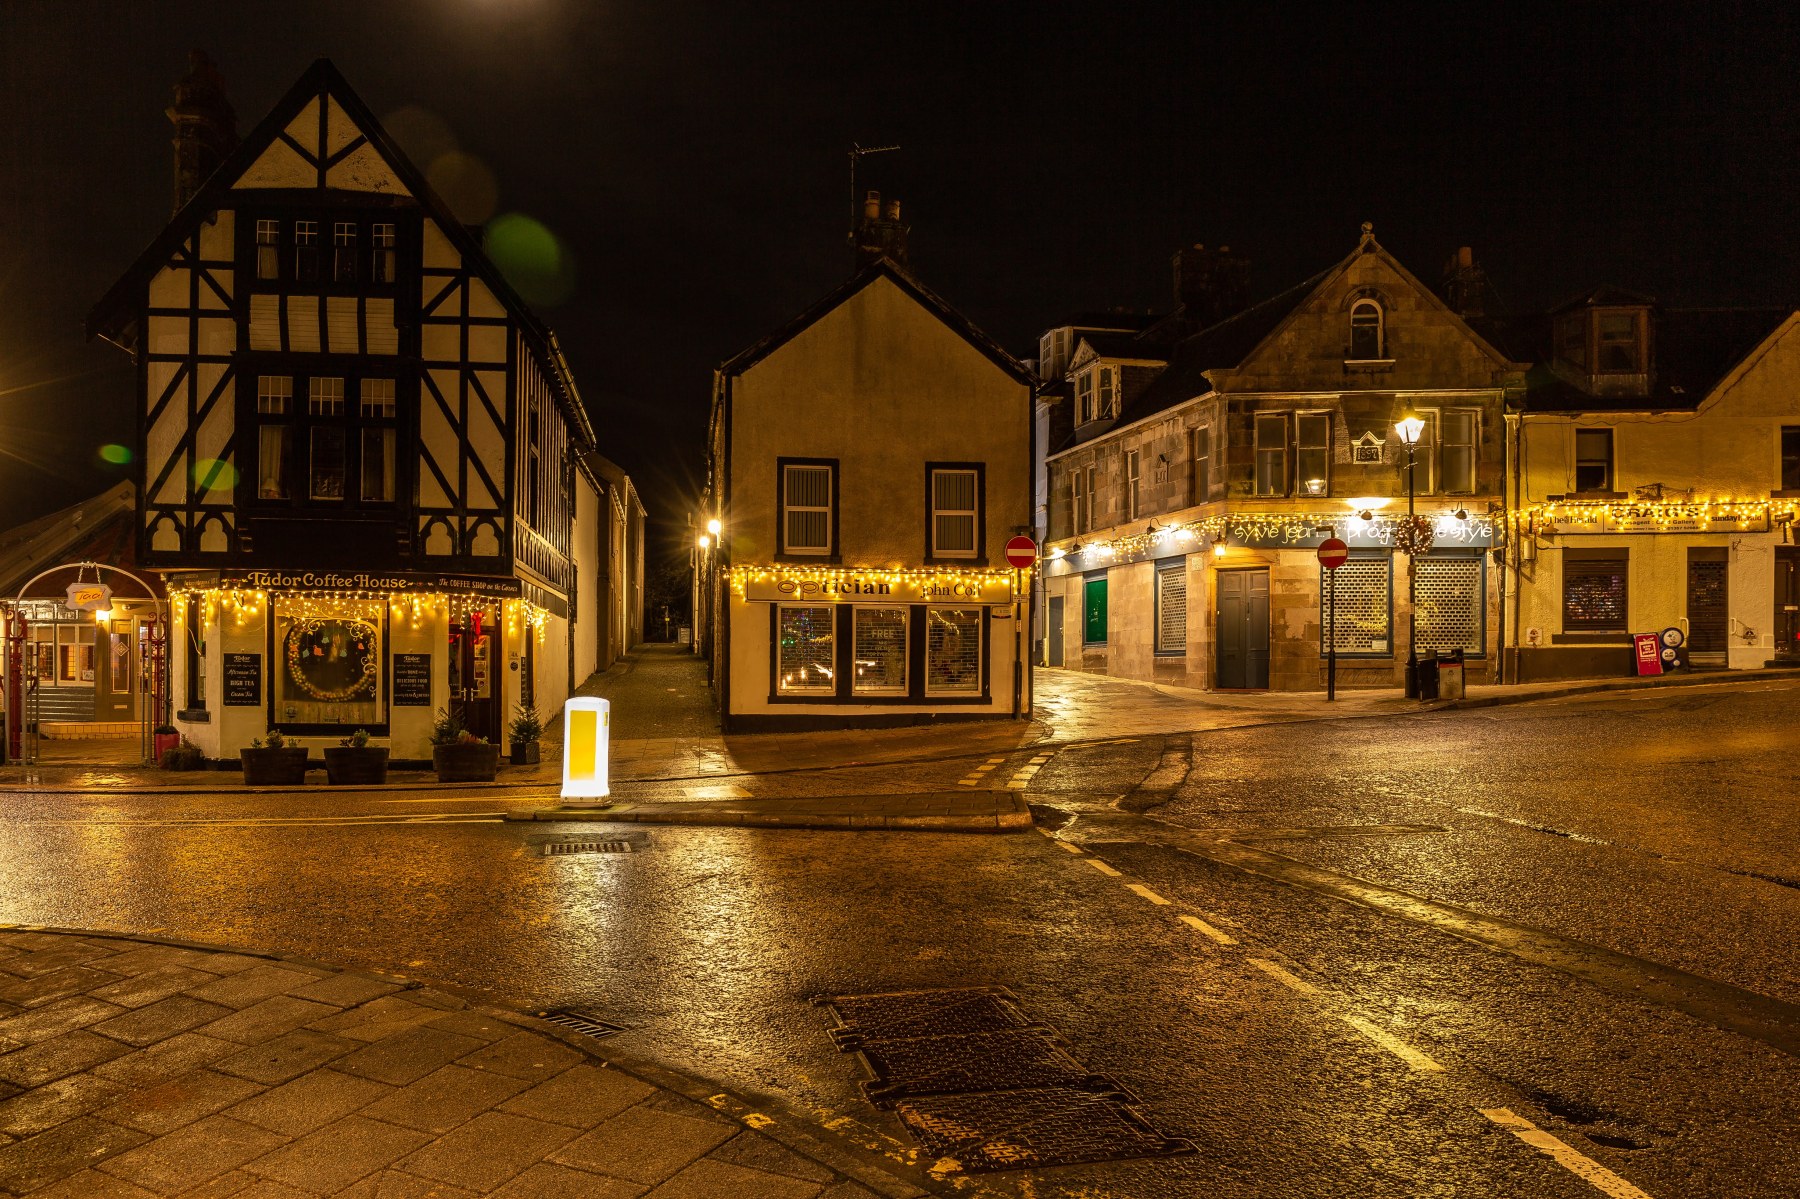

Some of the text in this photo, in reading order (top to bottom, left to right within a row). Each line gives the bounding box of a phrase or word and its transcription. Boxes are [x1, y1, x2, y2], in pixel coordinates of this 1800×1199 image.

[1611, 507, 1699, 518] CRAIG'S
[1548, 516, 1564, 524] The
[1234, 525, 1279, 544] syvie
[1347, 525, 1447, 545] progre
[1450, 519, 1493, 544] style
[247, 571, 407, 588] Tudor Coffee House
[450, 579, 471, 588] COFFEE
[472, 581, 487, 590] SHOP
[777, 578, 891, 601] optician
[920, 583, 950, 599] john
[871, 630, 894, 638] FREE
